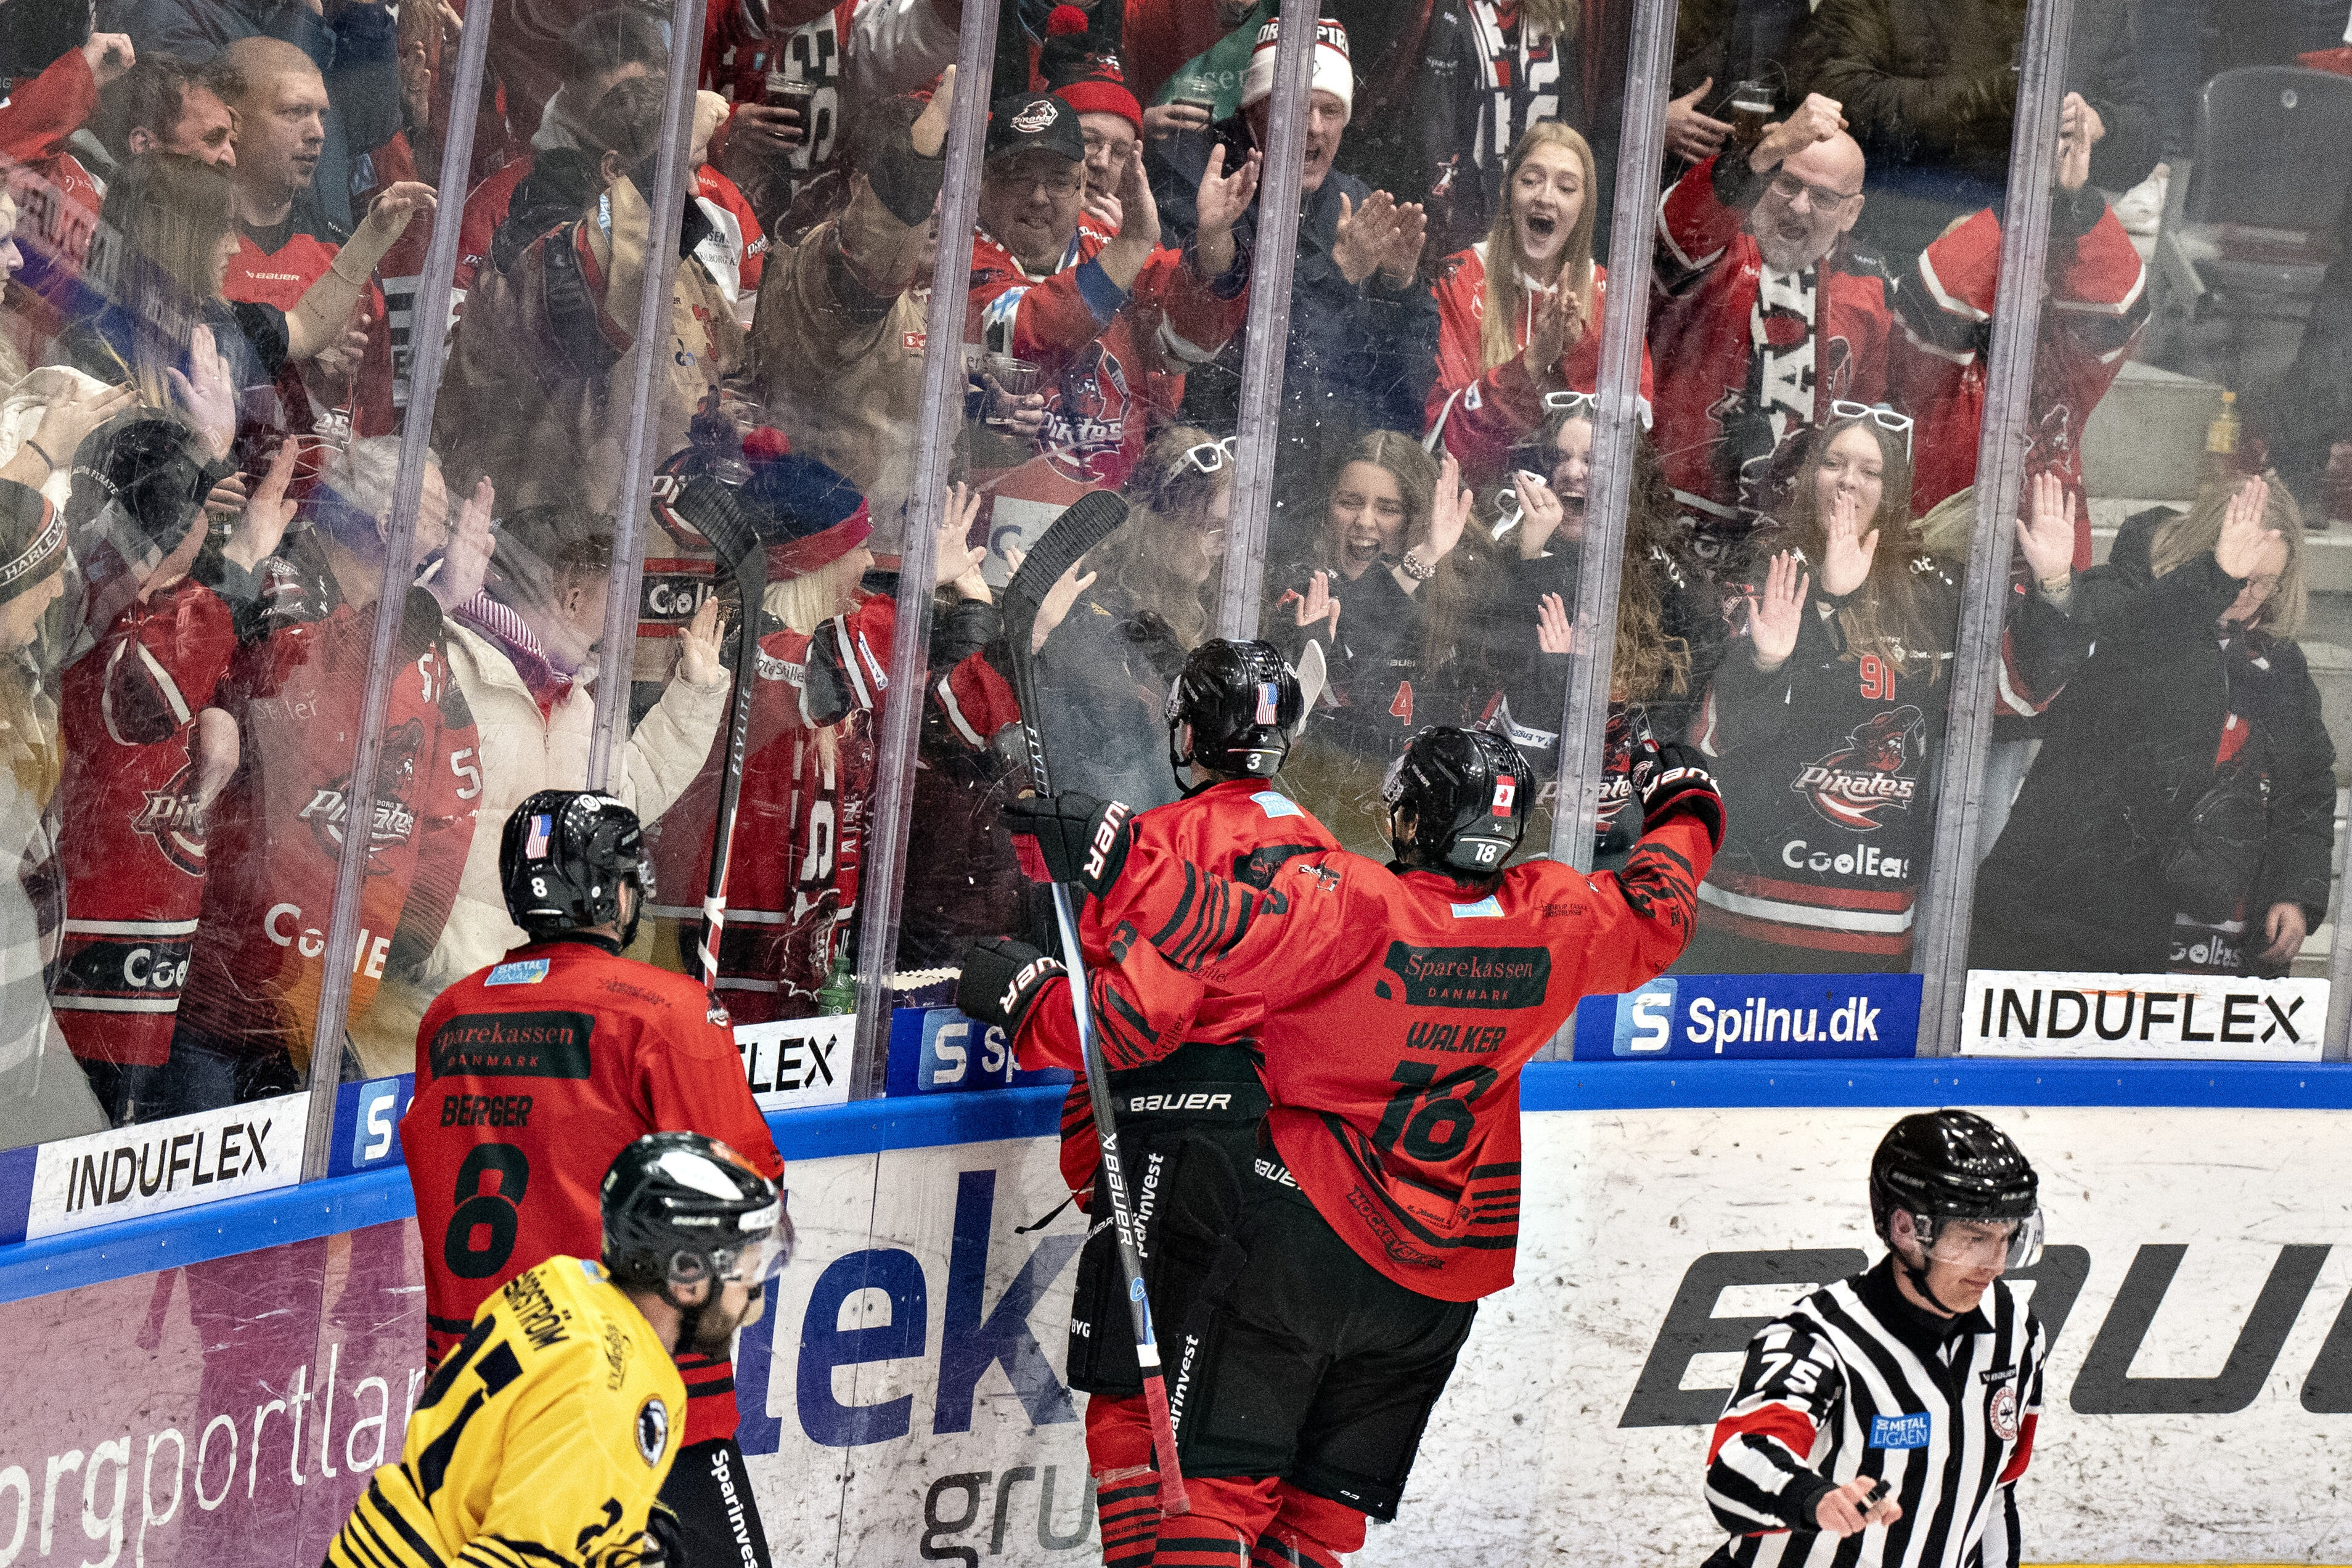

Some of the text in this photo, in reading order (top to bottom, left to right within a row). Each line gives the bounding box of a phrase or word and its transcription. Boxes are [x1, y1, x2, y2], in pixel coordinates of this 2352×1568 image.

[1860, 654, 1895, 701] 91
[1388, 680, 1414, 725] 4
[1246, 753, 1262, 770] 3
[1795, 766, 1914, 802] Pirates
[1475, 843, 1497, 863] 18
[531, 877, 548, 898] 8
[1406, 954, 1533, 979] Sparekassen
[1428, 987, 1509, 1001] DANMARK
[1405, 1021, 1507, 1053] WALKER
[1686, 996, 1881, 1054] Spilnu.dk
[1980, 988, 2305, 1044] INDUFLEX
[738, 1034, 838, 1095] LEX
[440, 1094, 534, 1128] BERGER
[1130, 1093, 1232, 1113] BAUER
[1371, 1060, 1499, 1162] 18
[65, 1118, 272, 1213] INDUFLEX
[443, 1143, 529, 1279] 8
[1106, 1153, 1133, 1247] BAUER
[1136, 1153, 1164, 1258] parinvest
[1755, 1352, 1823, 1394] 75
[1890, 1416, 1927, 1431] METAL
